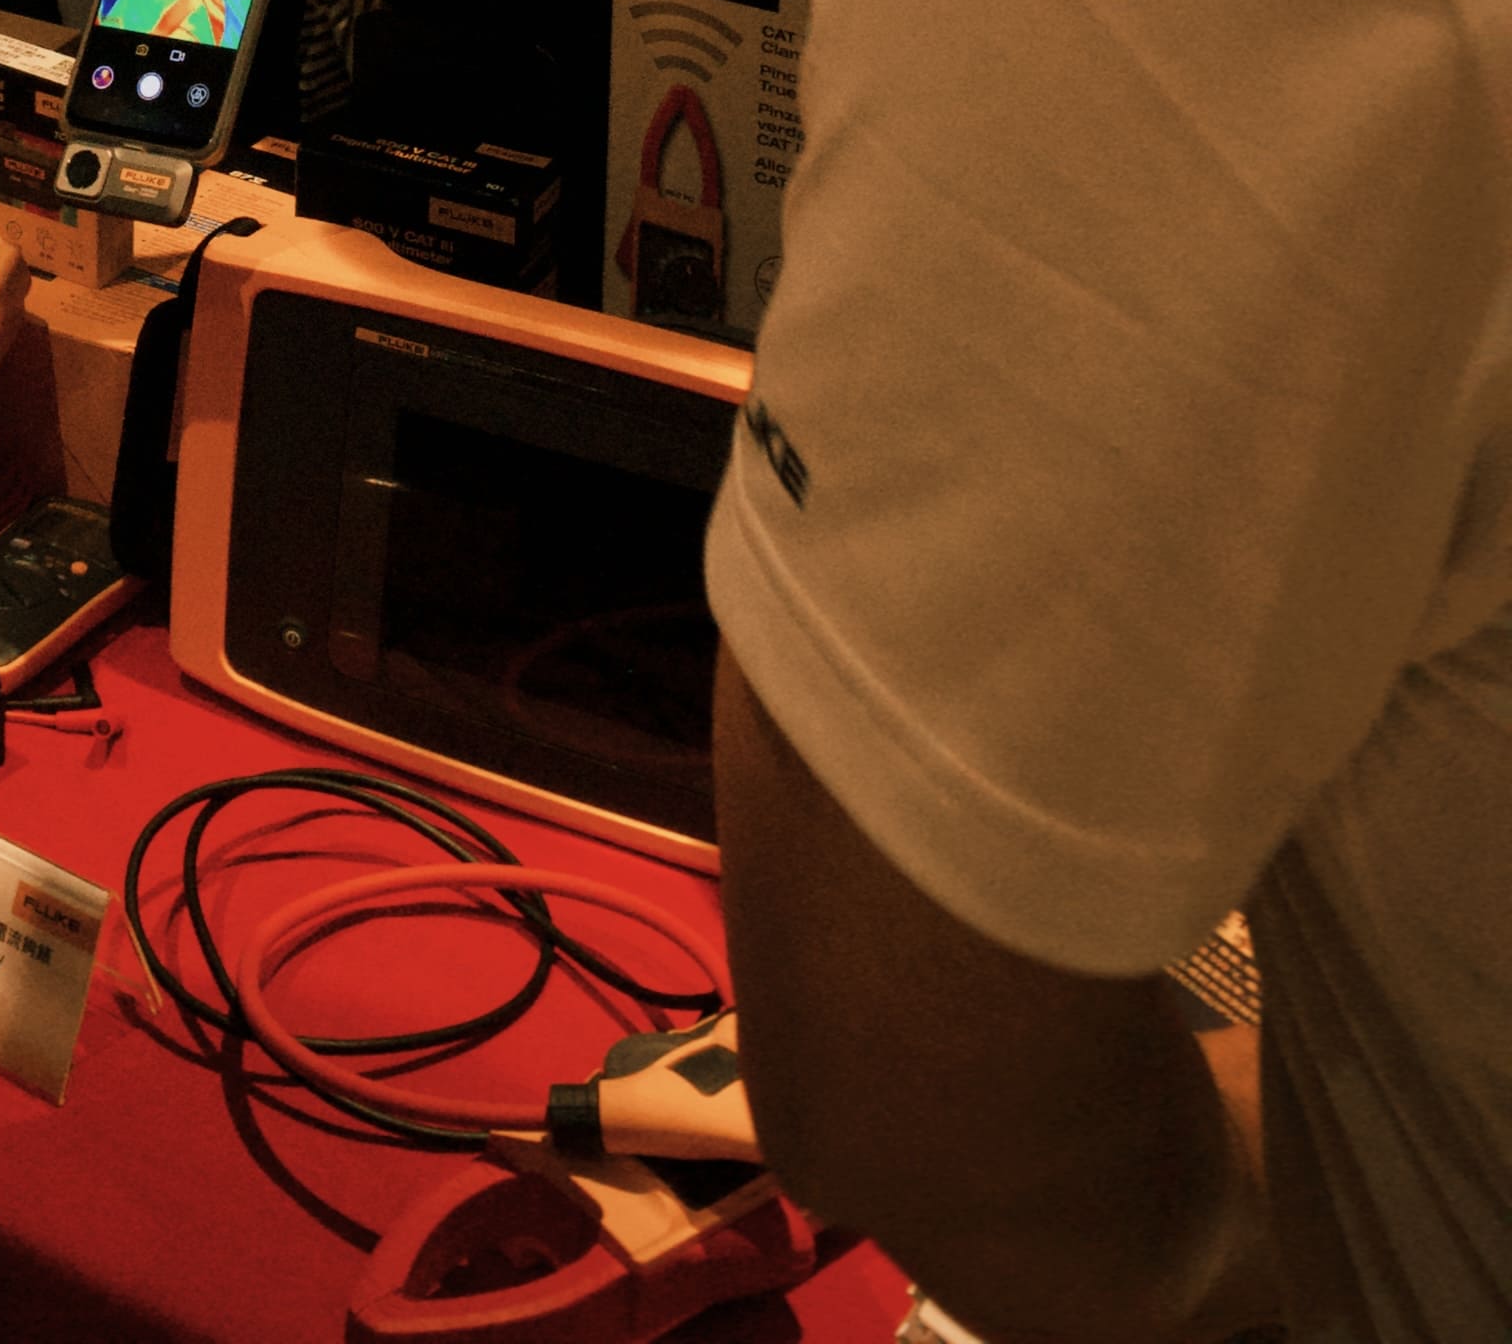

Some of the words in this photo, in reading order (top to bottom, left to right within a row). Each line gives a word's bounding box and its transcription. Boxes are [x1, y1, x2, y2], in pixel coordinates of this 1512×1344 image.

[761, 24, 796, 44] CAT
[759, 63, 797, 84] Pinc
[756, 134, 791, 153] CAT
[124, 171, 166, 187] FLUKE
[22, 894, 82, 933] FLUKE
